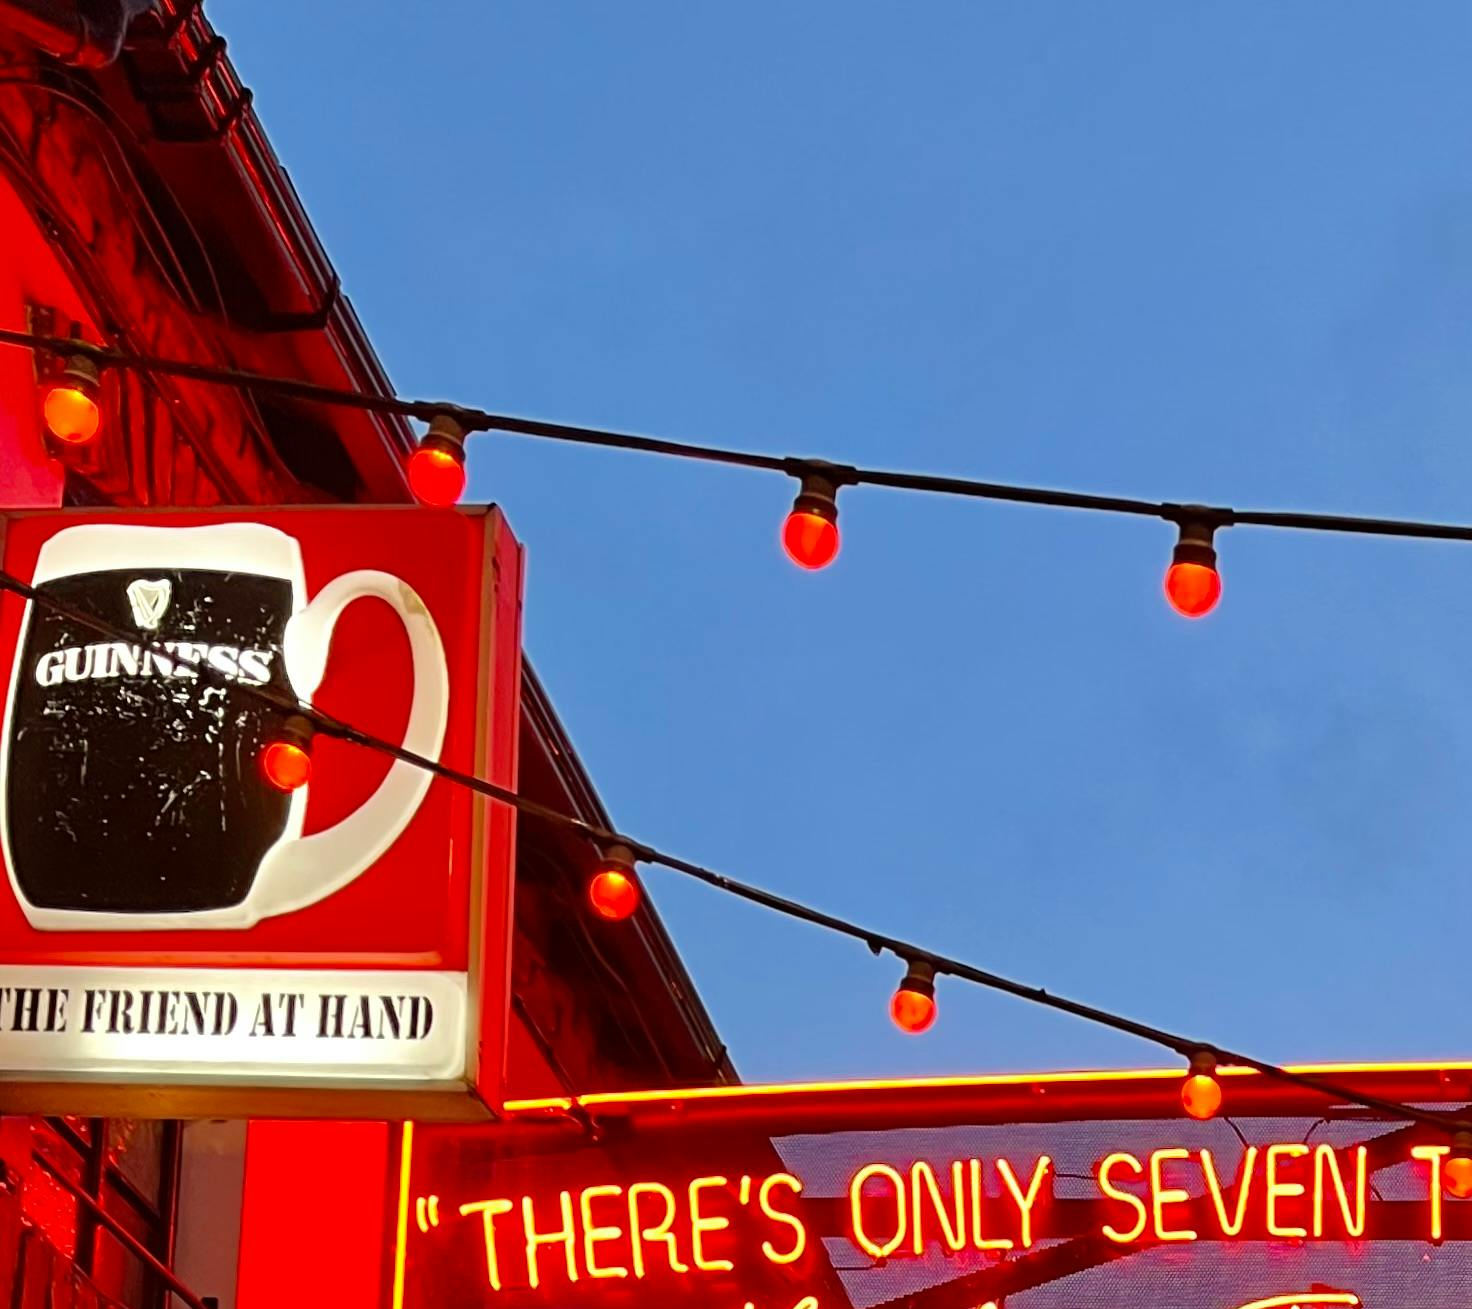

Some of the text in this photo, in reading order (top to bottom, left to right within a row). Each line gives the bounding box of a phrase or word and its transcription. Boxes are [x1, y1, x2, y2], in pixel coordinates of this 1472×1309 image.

[36, 642, 272, 687] GUINNESS
[0, 988, 435, 1041] THE FRIEND AT HAND
[849, 1155, 1051, 1257] ONLY
[1099, 1143, 1368, 1243] SEVEN
